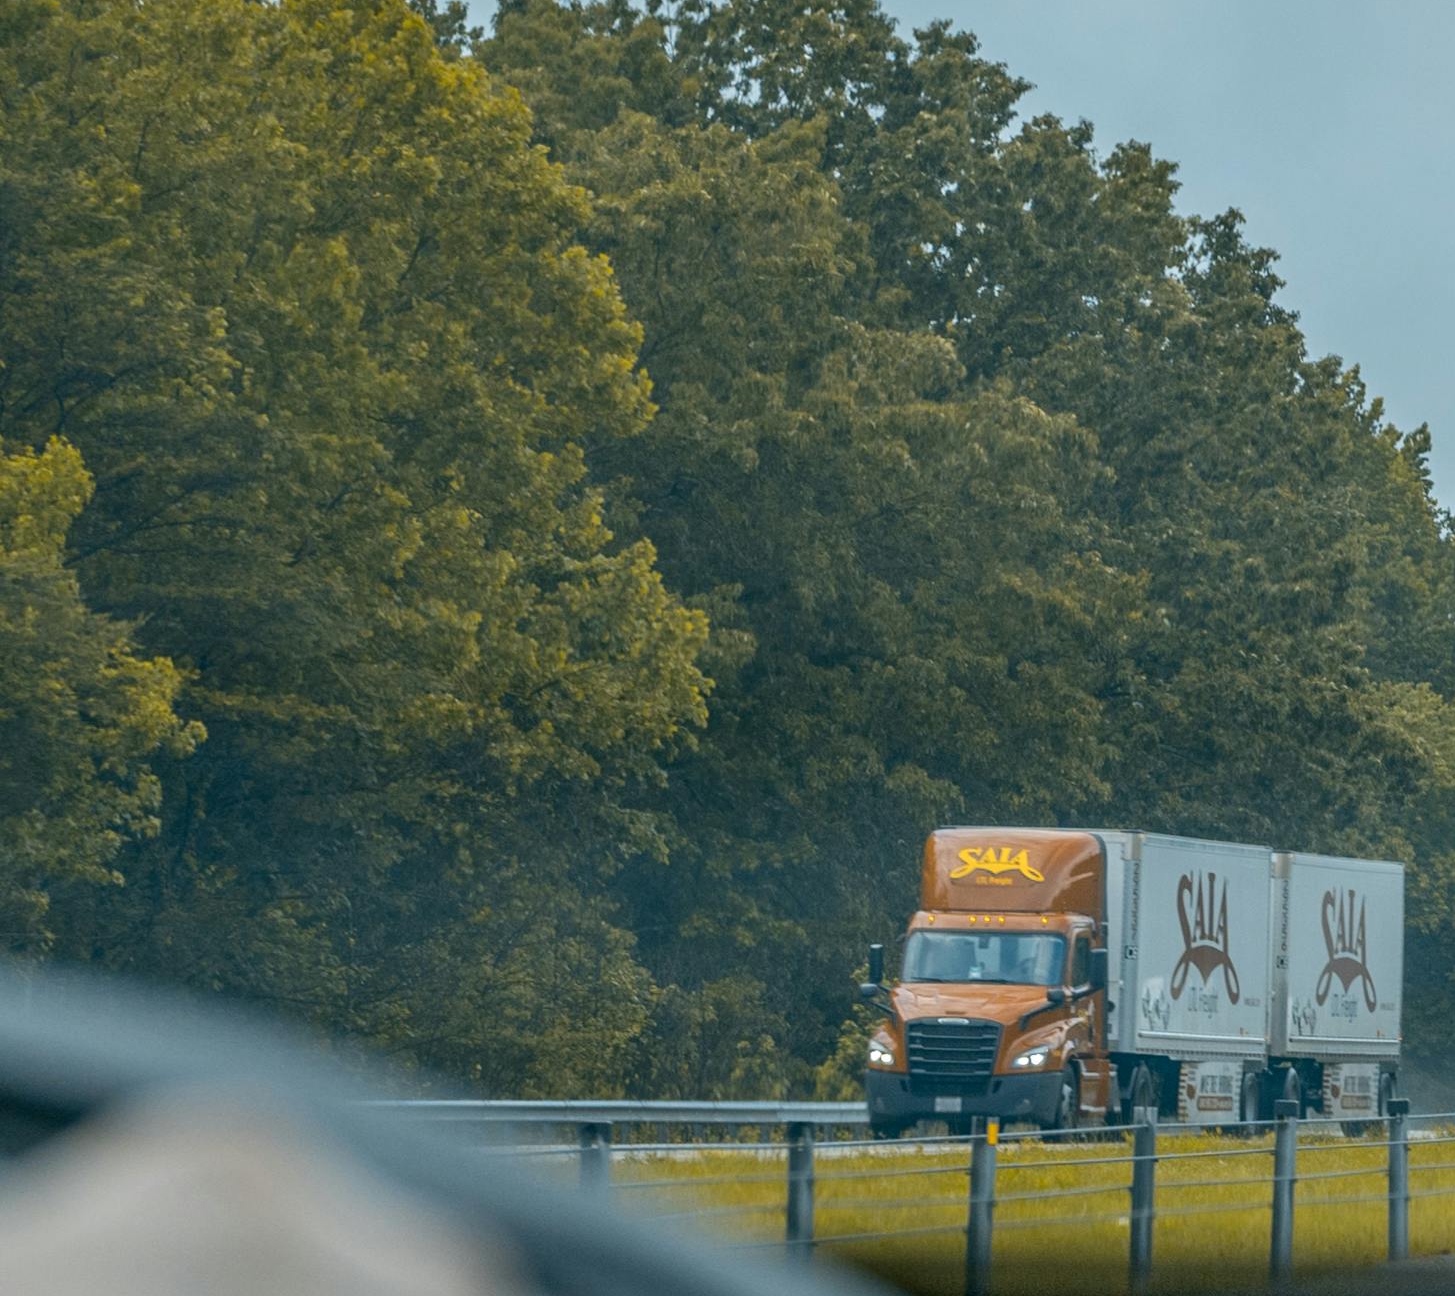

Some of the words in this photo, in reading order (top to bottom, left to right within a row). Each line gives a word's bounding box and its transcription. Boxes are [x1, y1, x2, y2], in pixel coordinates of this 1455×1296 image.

[949, 847, 1045, 882] SAIA
[1170, 868, 1240, 1005] SAIA
[1316, 885, 1377, 1013] SAIA
